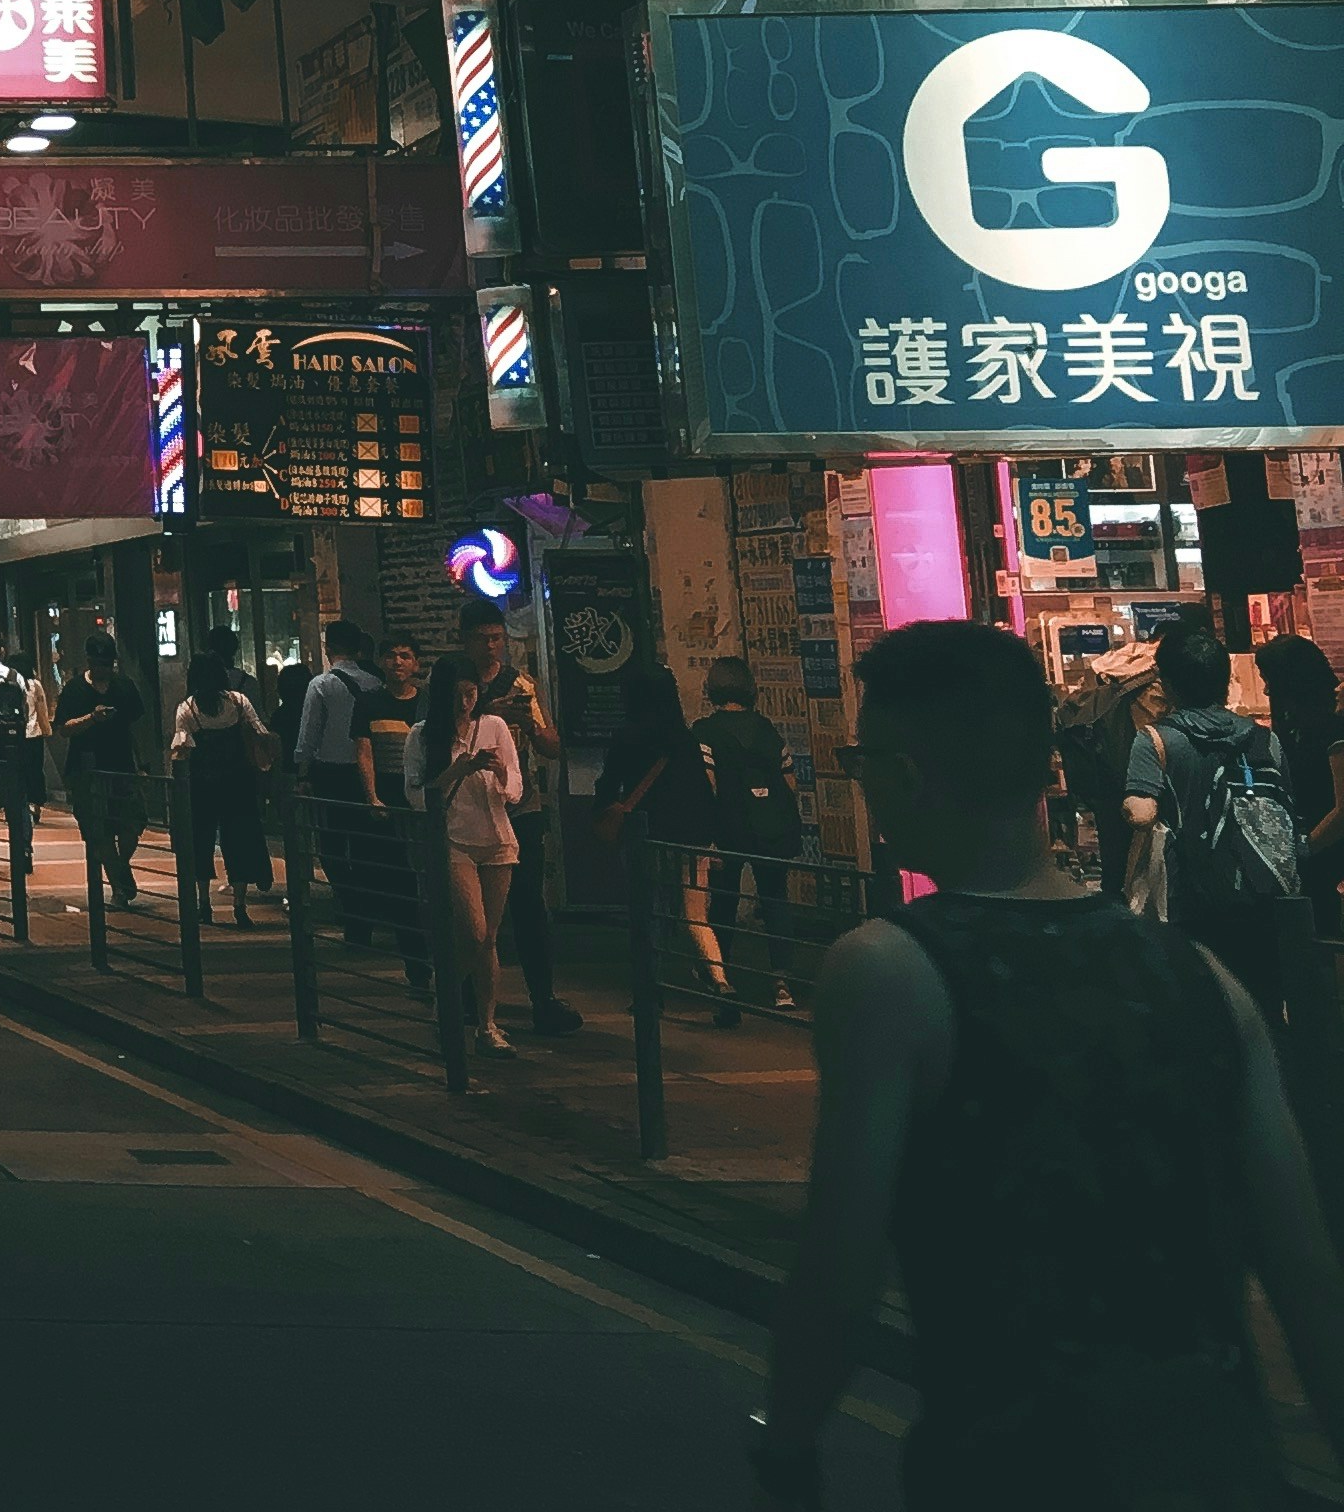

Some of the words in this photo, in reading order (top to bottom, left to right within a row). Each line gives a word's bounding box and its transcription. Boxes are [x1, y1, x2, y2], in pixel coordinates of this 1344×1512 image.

[902, 28, 1171, 291] G
[1135, 270, 1248, 301] googa
[291, 352, 344, 372] HAIR
[350, 354, 418, 375] SALON
[858, 313, 1261, 405] 護家美視
